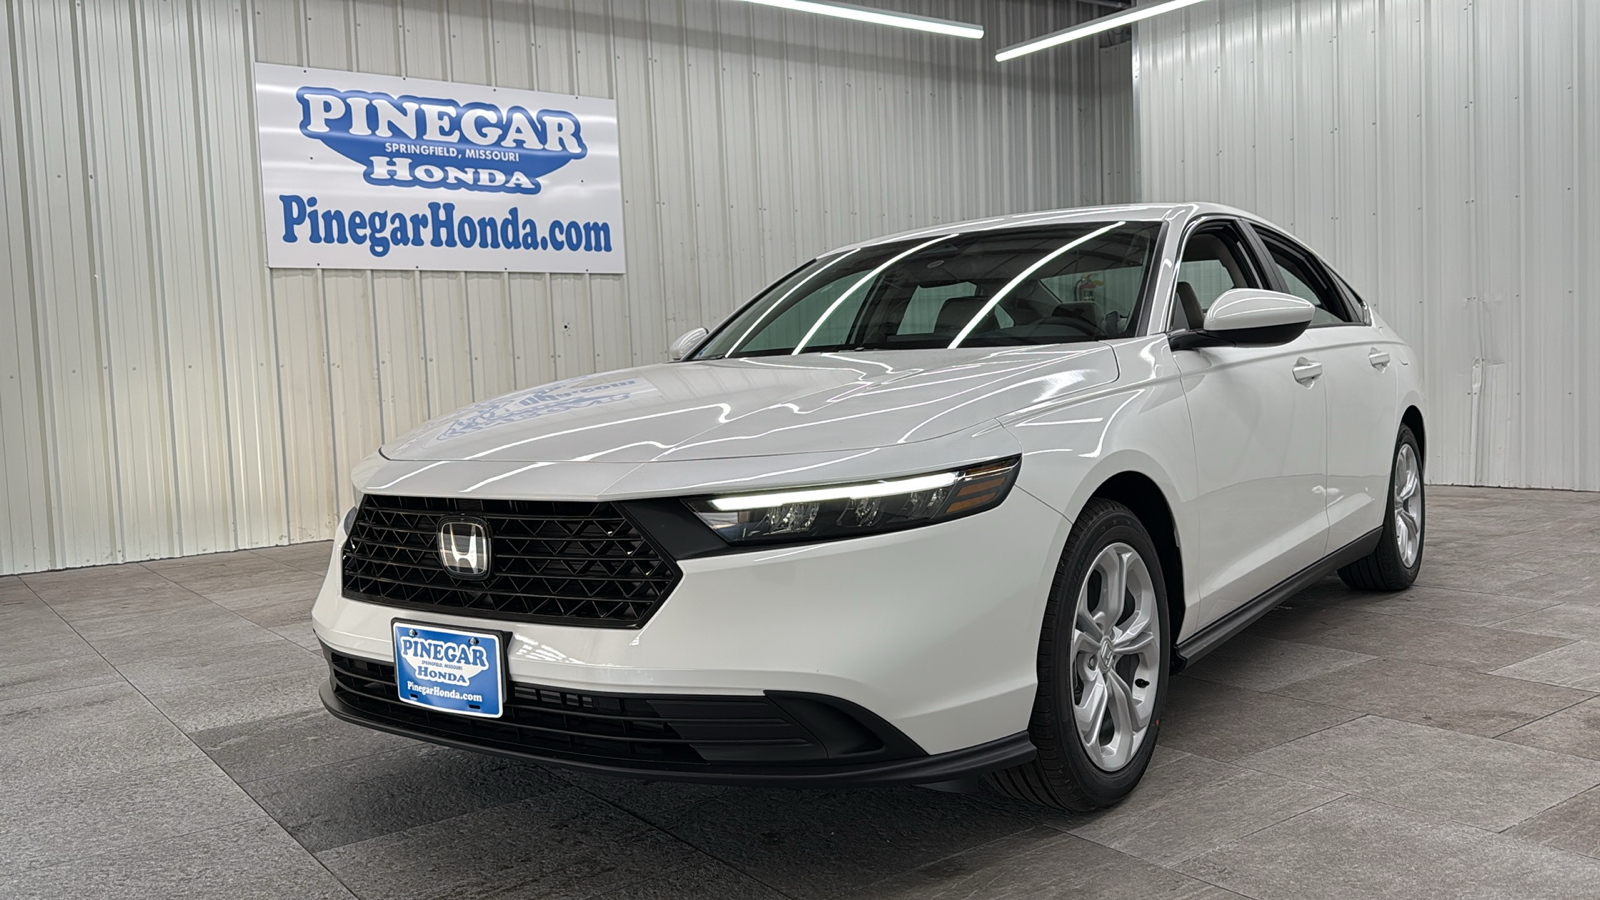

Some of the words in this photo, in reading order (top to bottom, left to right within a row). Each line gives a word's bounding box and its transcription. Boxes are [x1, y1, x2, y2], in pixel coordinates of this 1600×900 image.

[303, 93, 582, 154] PINEGAR
[385, 142, 462, 159] SPRINGFIELD,
[465, 149, 519, 162] MISSOURI
[369, 156, 536, 189] HONDA
[279, 194, 613, 257] PinegarHonda.com
[402, 639, 487, 667] PINEGAR
[417, 666, 468, 684] HONDA
[406, 681, 483, 702] PinegarHonda.com
